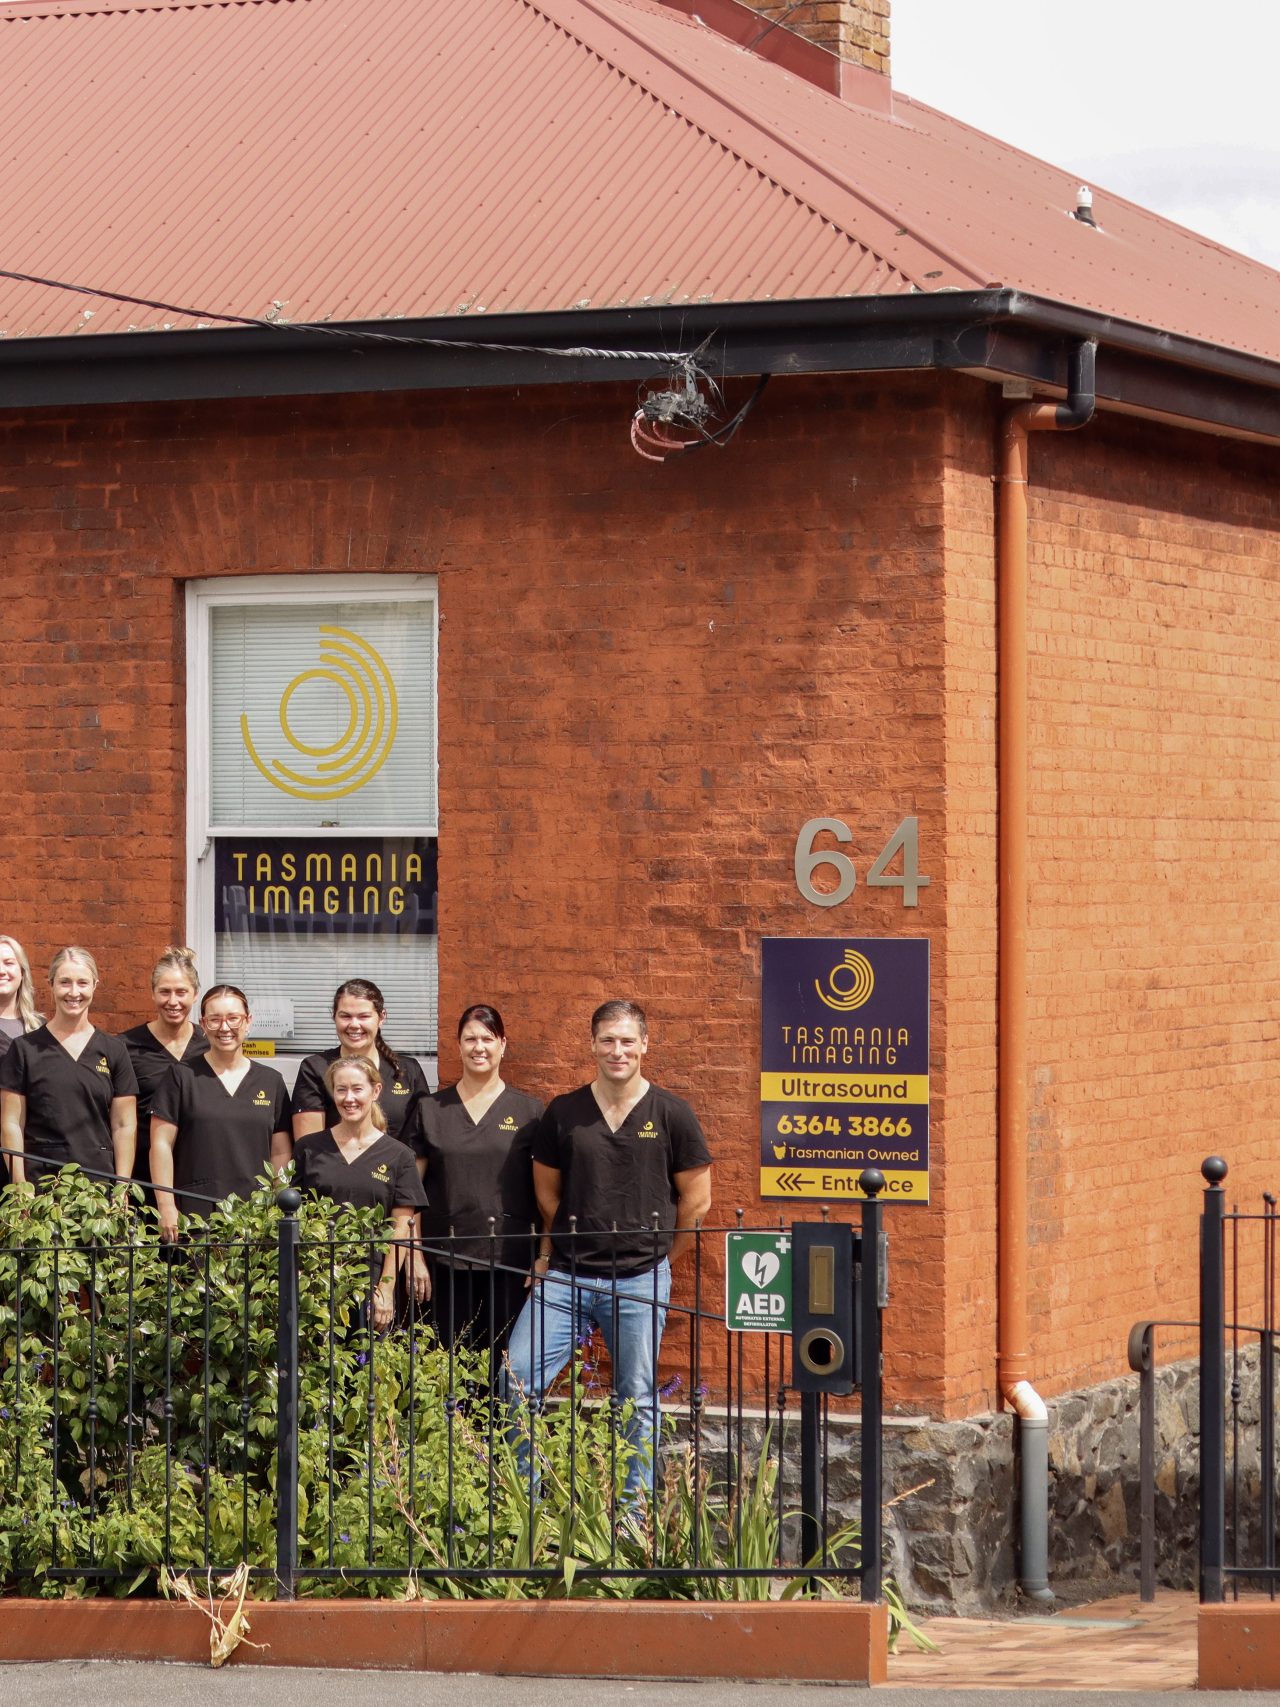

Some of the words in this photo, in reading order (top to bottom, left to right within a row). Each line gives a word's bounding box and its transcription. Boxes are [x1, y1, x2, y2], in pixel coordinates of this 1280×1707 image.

[232, 853, 422, 882] TASMANIA
[794, 816, 931, 908] 64
[249, 886, 405, 915] IMAGING
[782, 1026, 909, 1046] TASMANIA
[792, 1045, 897, 1065] IMAGING
[781, 1078, 908, 1098] Ultrasound
[777, 1114, 841, 1136] 6364
[848, 1116, 912, 1137] 3866
[788, 1146, 864, 1160] Tasmanian
[867, 1148, 919, 1161] Owned
[822, 1175, 914, 1193] Entrce
[736, 1293, 786, 1316] AED
